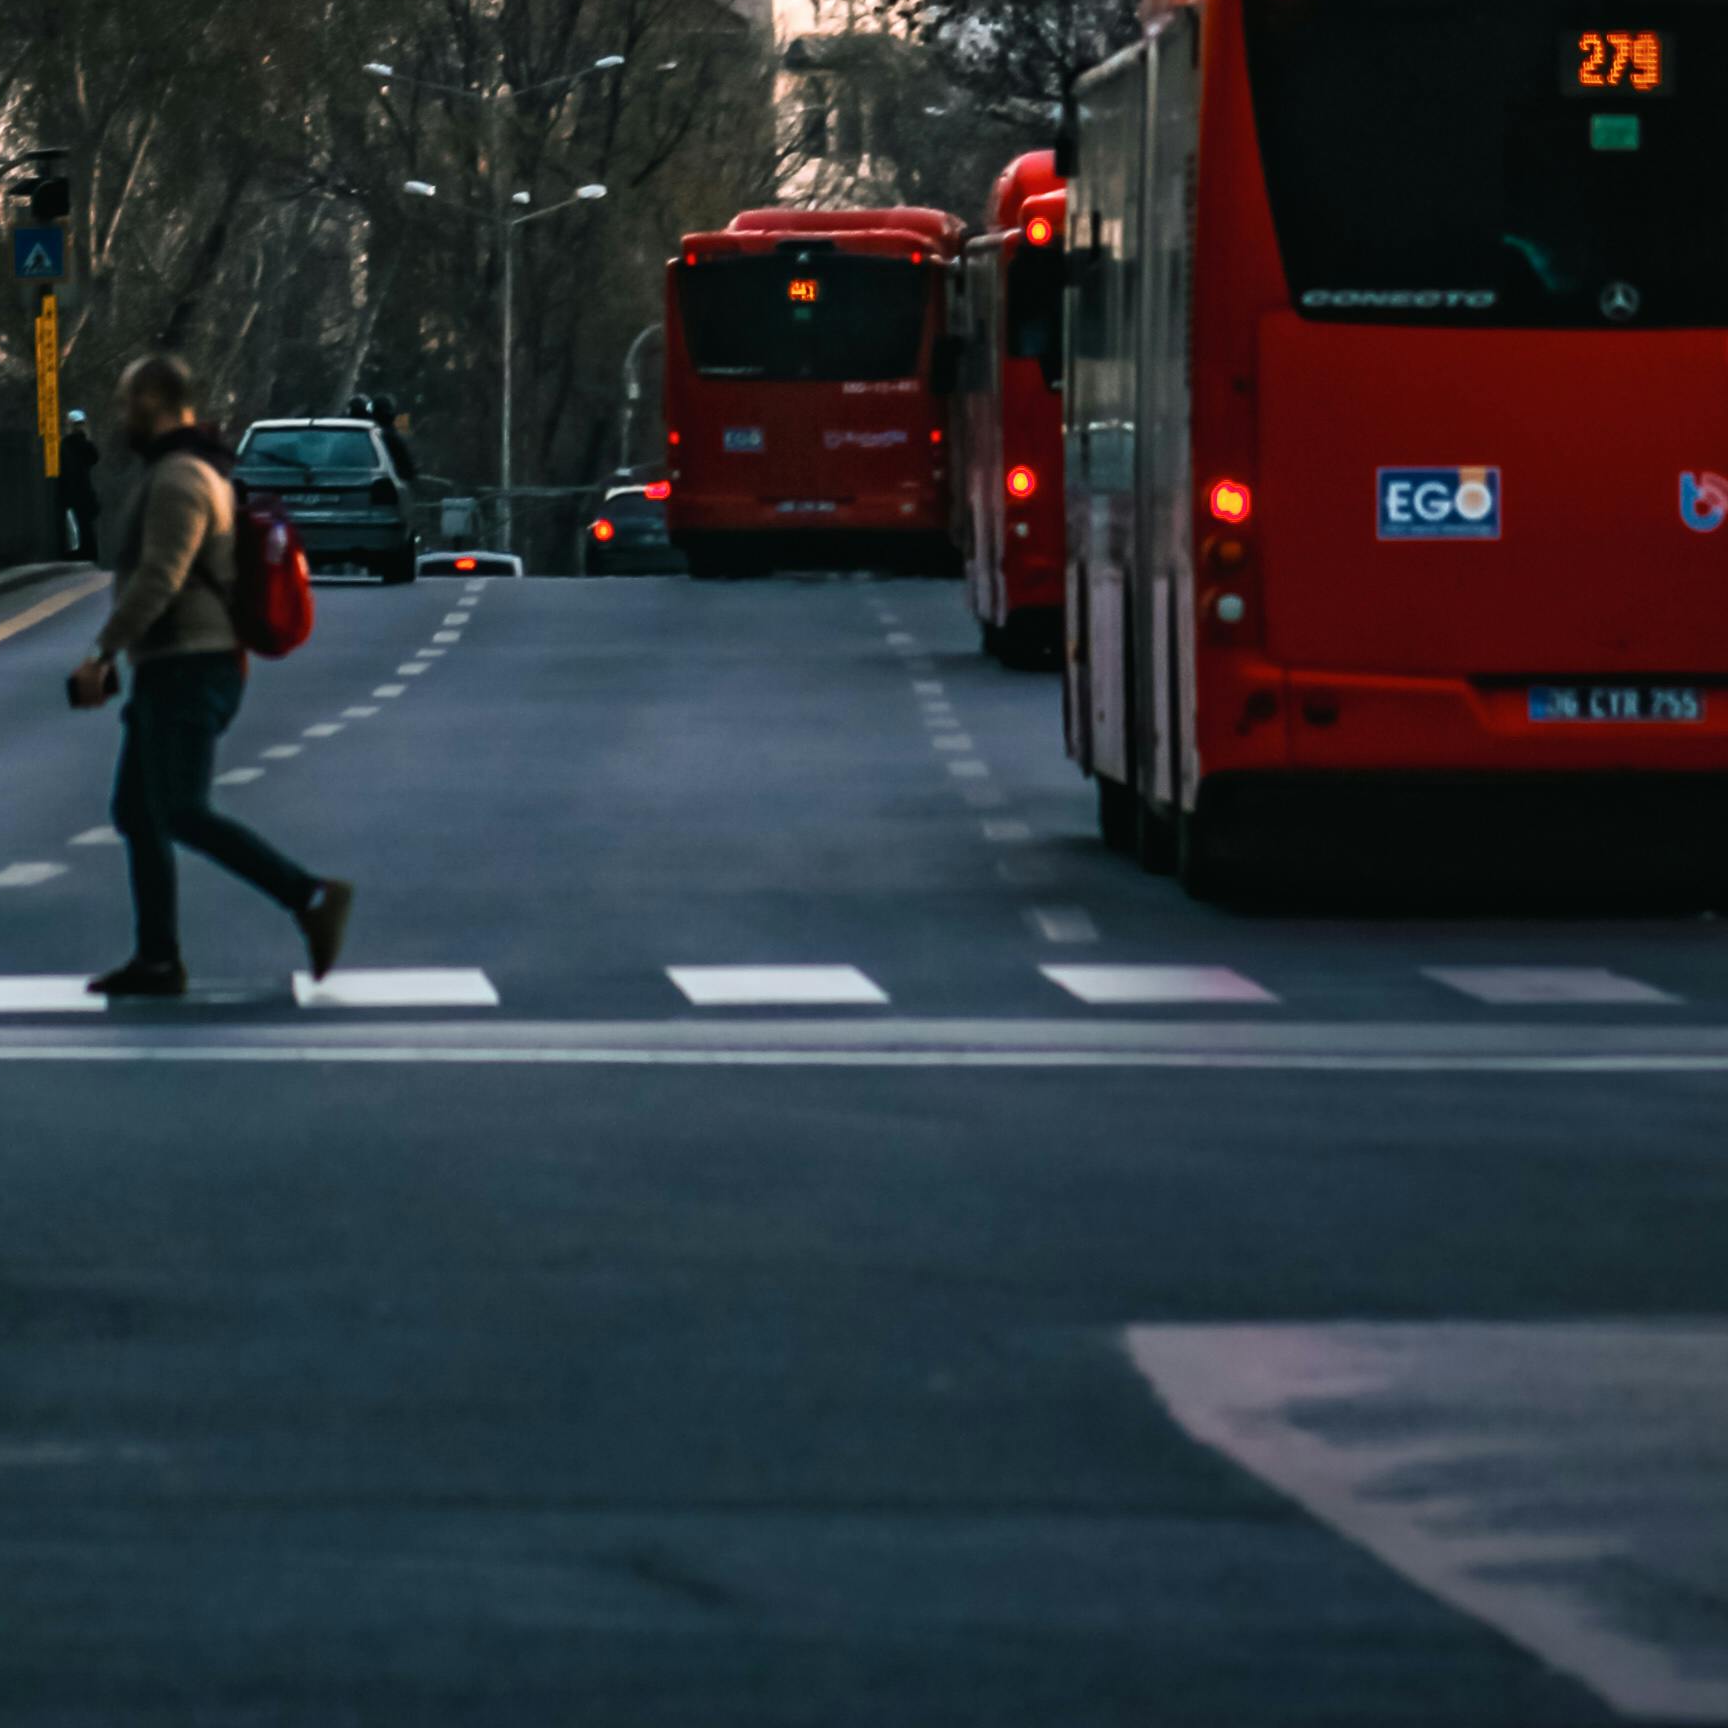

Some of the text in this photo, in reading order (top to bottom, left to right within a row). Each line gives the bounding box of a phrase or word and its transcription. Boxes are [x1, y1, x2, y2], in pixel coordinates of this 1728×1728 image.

[1579, 32, 1660, 90] 279
[1302, 289, 1495, 308] CONECTO
[1387, 480, 1493, 522] EGO
